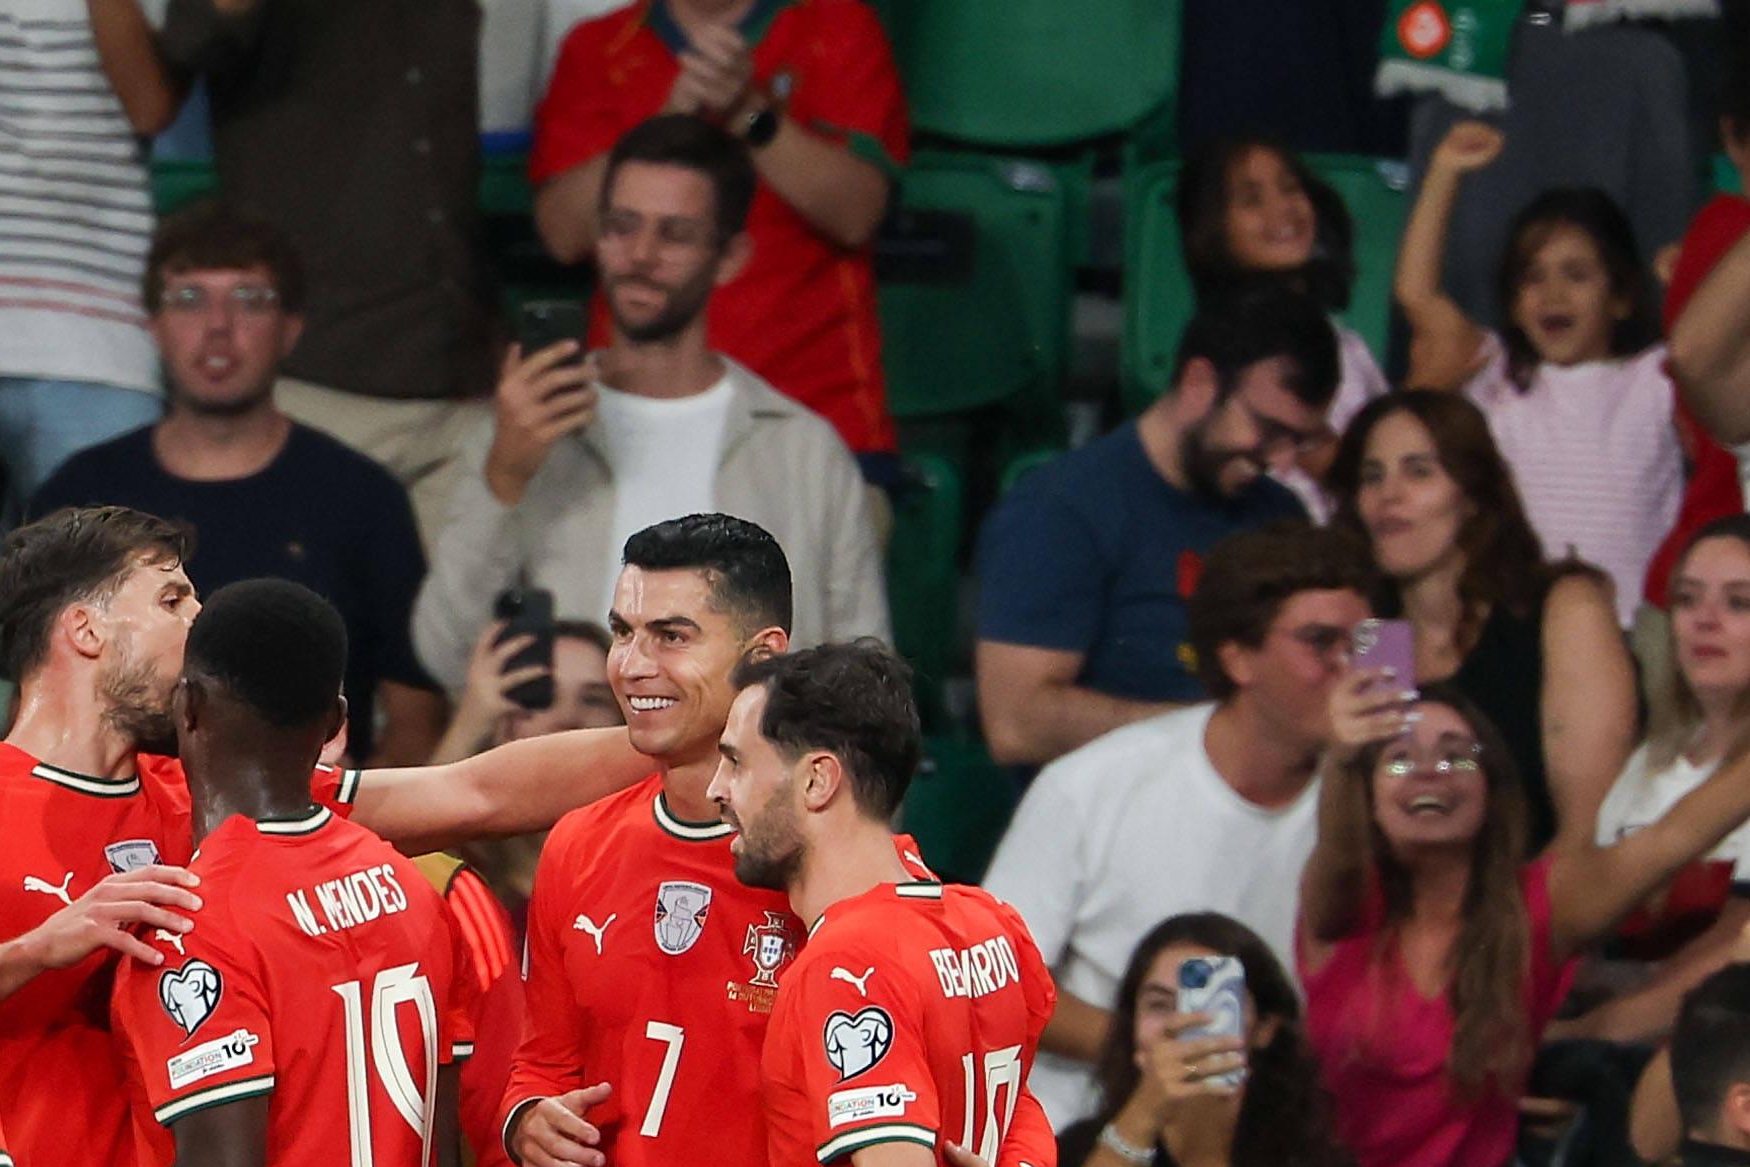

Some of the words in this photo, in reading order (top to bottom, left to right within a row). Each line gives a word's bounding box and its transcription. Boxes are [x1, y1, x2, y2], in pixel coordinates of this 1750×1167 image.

[286, 888, 328, 937] N.
[314, 863, 408, 932] MENDES
[639, 1020, 684, 1137] 7
